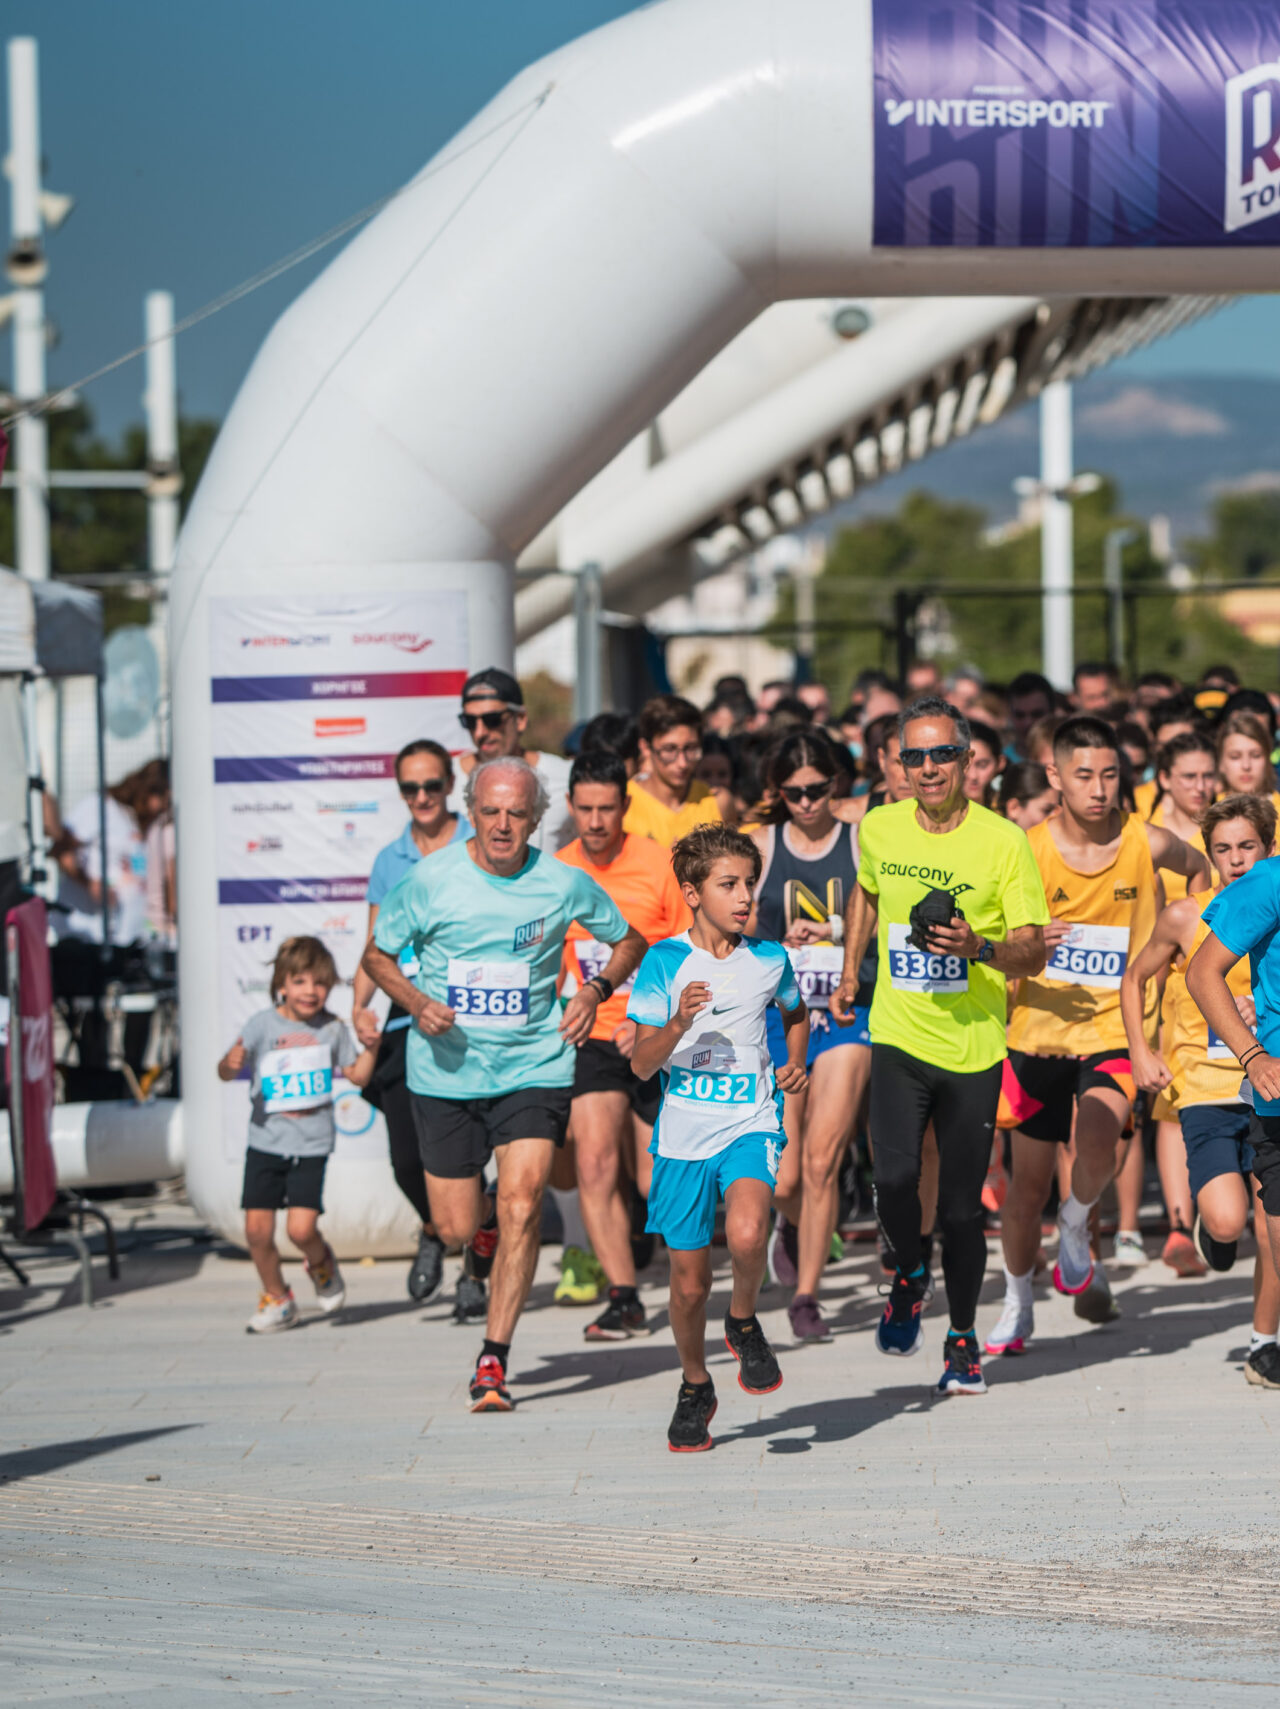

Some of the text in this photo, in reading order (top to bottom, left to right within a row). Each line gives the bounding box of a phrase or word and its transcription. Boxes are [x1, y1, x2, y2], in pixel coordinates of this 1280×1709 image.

[916, 99, 1109, 128] INTERSPORT
[880, 861, 954, 886] saucony
[516, 920, 543, 946] RUN
[895, 952, 962, 979] 3368
[1054, 945, 1120, 975] 3600
[454, 988, 523, 1014] 3368
[692, 1052, 711, 1067] RUN
[268, 1072, 327, 1100] 3418
[676, 1070, 750, 1102] 3032
